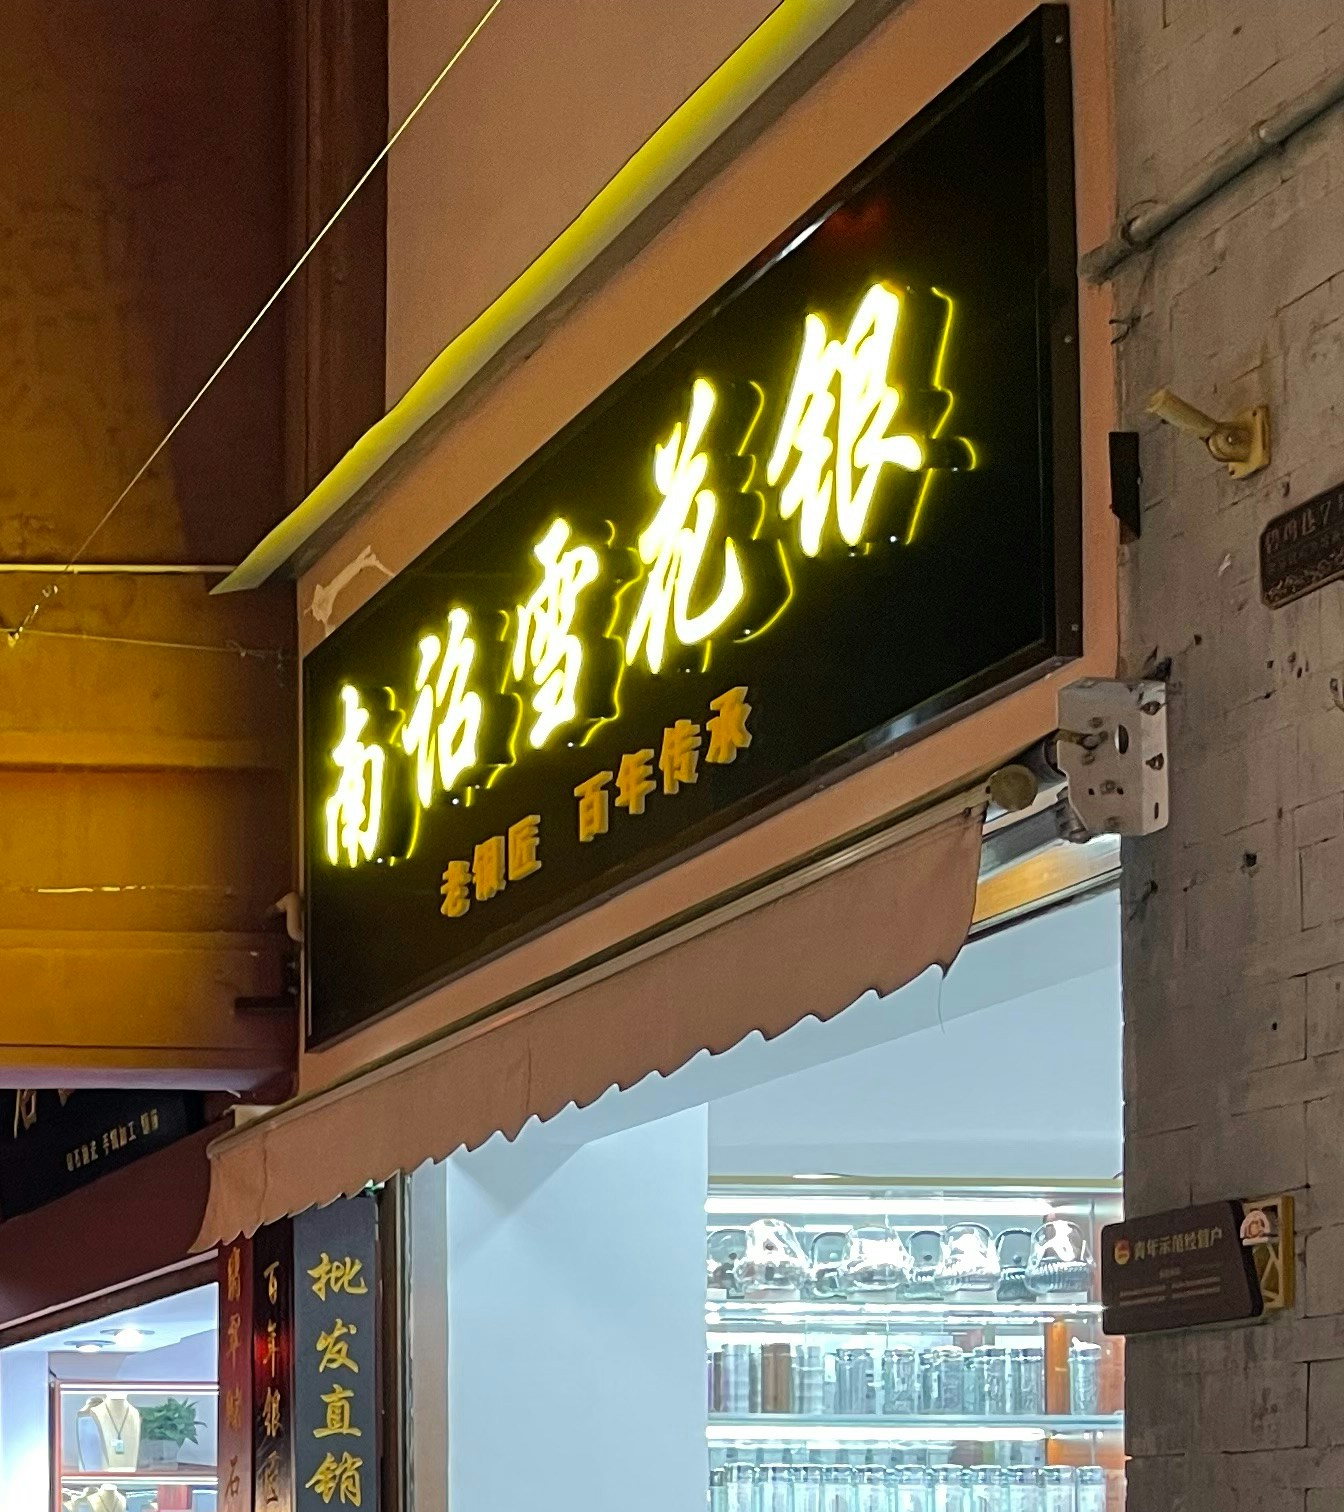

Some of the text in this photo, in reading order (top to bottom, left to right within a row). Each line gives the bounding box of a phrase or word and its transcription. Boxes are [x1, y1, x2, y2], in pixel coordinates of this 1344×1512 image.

[440, 685, 753, 918] 老银匠 百年传承
[306, 1251, 369, 1508] 批发直销
